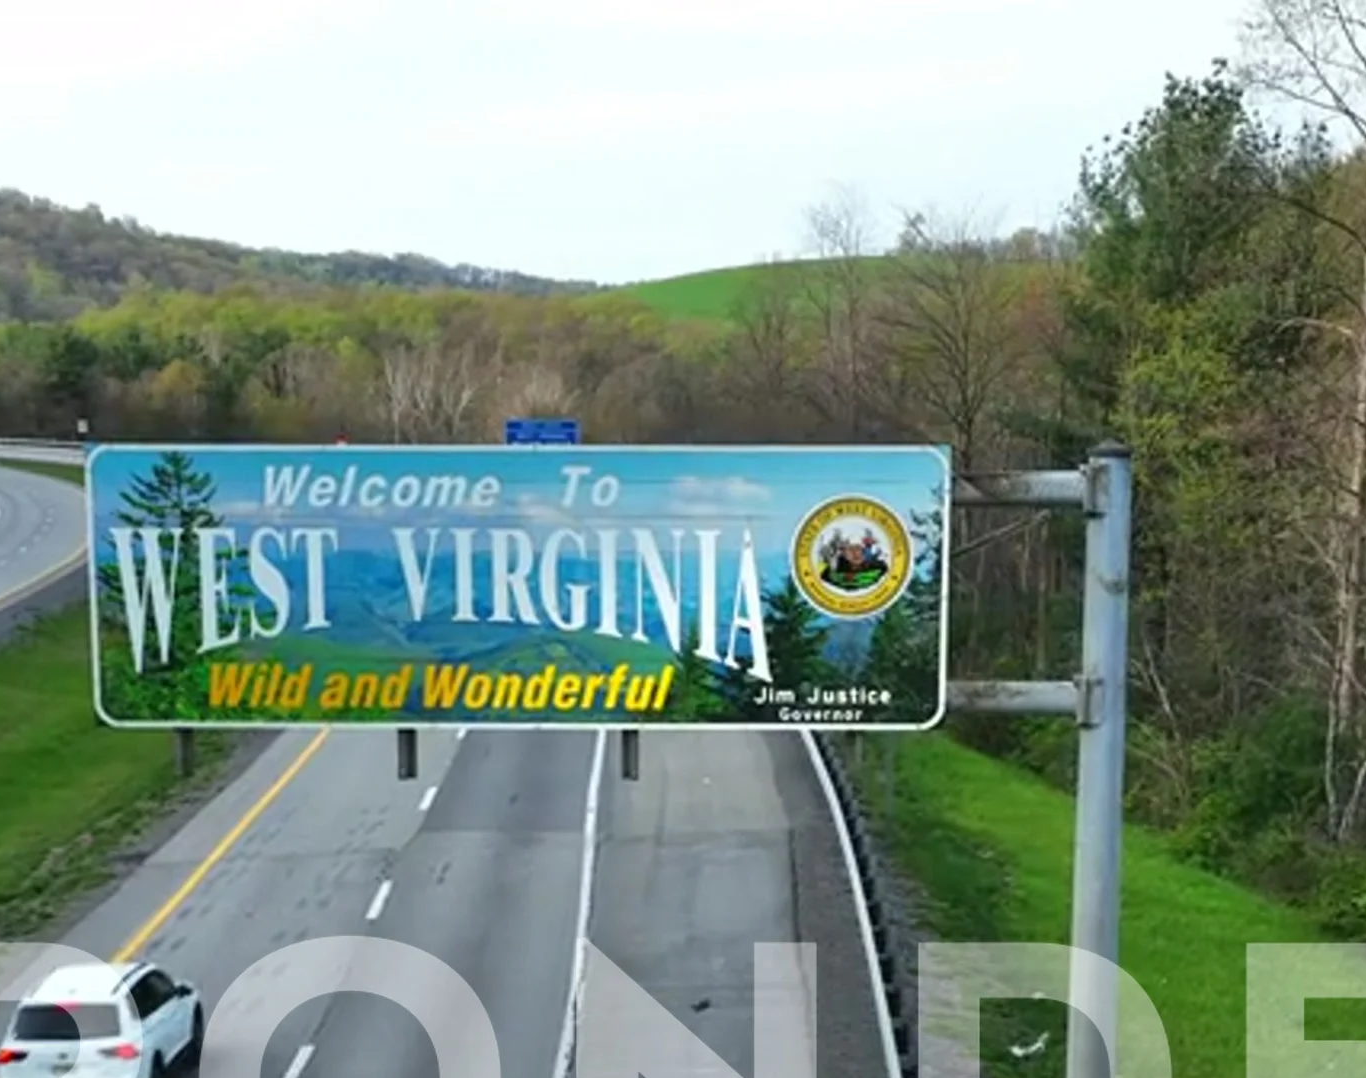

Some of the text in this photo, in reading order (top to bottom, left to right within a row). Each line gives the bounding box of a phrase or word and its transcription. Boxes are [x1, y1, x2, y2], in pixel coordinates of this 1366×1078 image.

[263, 464, 620, 509] Welcome To
[109, 523, 774, 683] WEST VIRGINIA
[208, 662, 676, 712] Wild and Wonderful
[753, 687, 892, 705] Jim Justice
[778, 706, 864, 722] Governor
